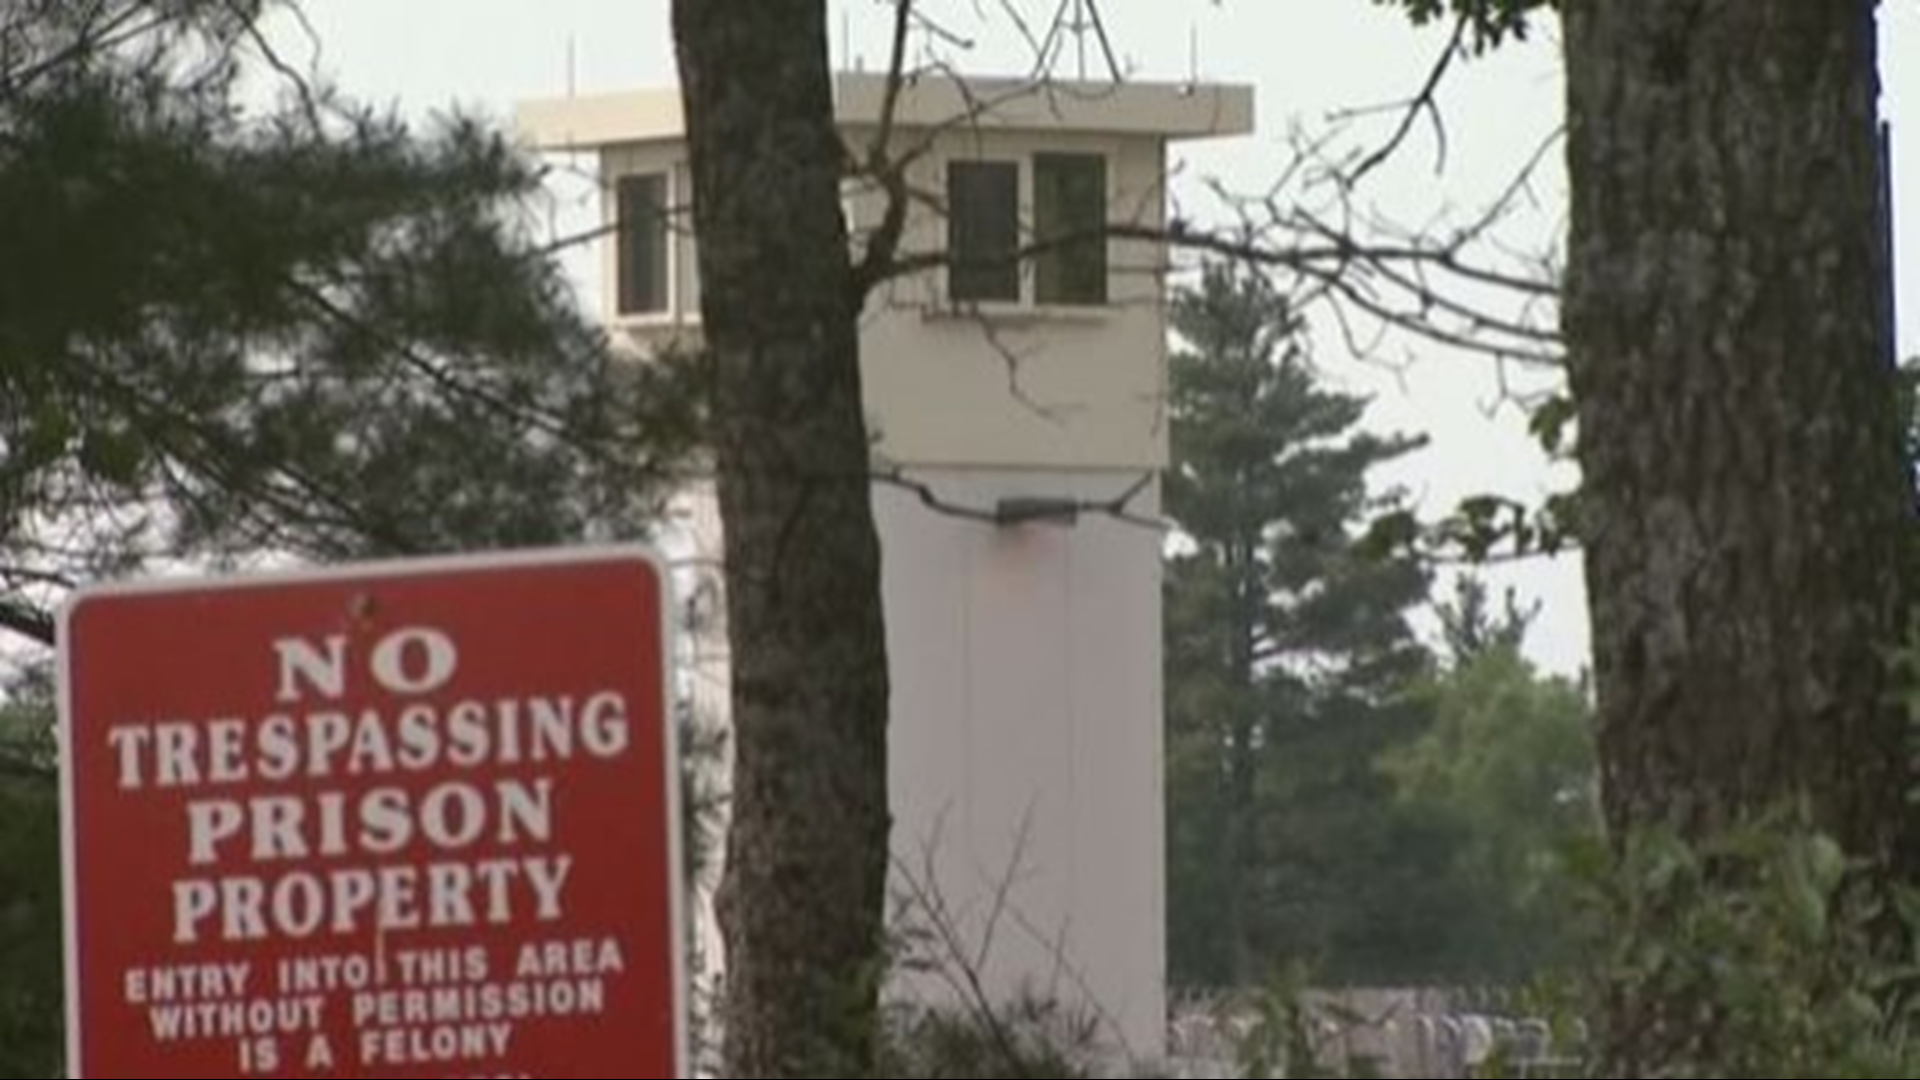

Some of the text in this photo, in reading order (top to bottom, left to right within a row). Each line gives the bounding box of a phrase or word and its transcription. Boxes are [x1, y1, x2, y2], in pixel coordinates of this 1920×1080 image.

[274, 627, 457, 700] NO
[109, 691, 629, 788] TRESPASSING
[187, 778, 553, 865] PRISON
[173, 856, 573, 943] PROPERTY
[124, 938, 624, 1003] ENTRY INTO THIS AREA
[149, 979, 604, 1041] WITHOUT PERMISSION
[239, 1022, 513, 1072] IS A FELONY
